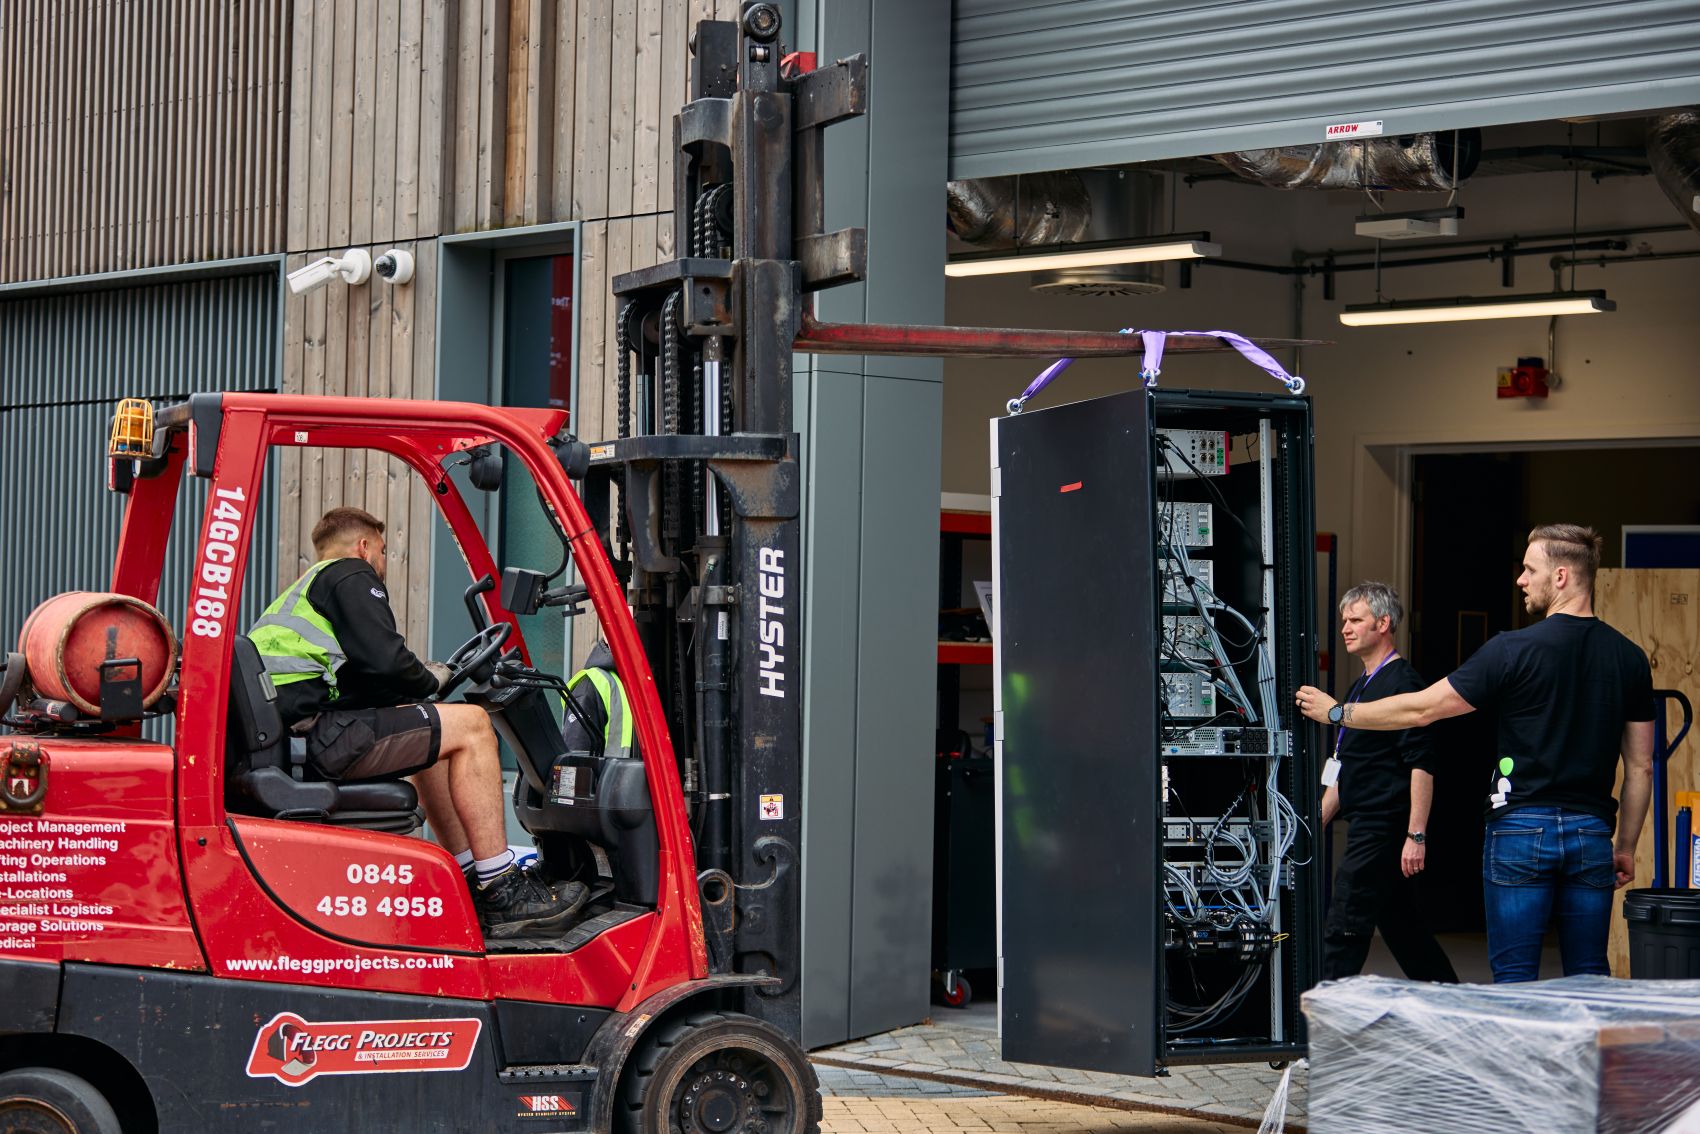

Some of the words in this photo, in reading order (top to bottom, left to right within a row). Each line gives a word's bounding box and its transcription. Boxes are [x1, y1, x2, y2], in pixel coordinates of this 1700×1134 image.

[1328, 124, 1359, 135] ARROW
[192, 486, 246, 638] 14GCB188
[759, 547, 785, 698] HYSTER
[37, 821, 126, 835] Management
[58, 837, 118, 851] Handling
[0, 854, 27, 868] ting
[31, 854, 106, 868] Operations
[346, 864, 414, 884] 0845
[0, 887, 73, 899] -Locations
[53, 903, 113, 917] Logistics
[316, 896, 367, 916] 458
[376, 897, 443, 917] 4958
[41, 920, 104, 932] Solutions
[226, 955, 454, 974] www.fleggprojects.co.uk
[290, 1032, 352, 1051] FLEGG
[356, 1030, 453, 1049] PROJECTS
[364, 1051, 412, 1059] INSTALLATION
[413, 1050, 445, 1058] SERVICES
[532, 1095, 559, 1111] HSS
